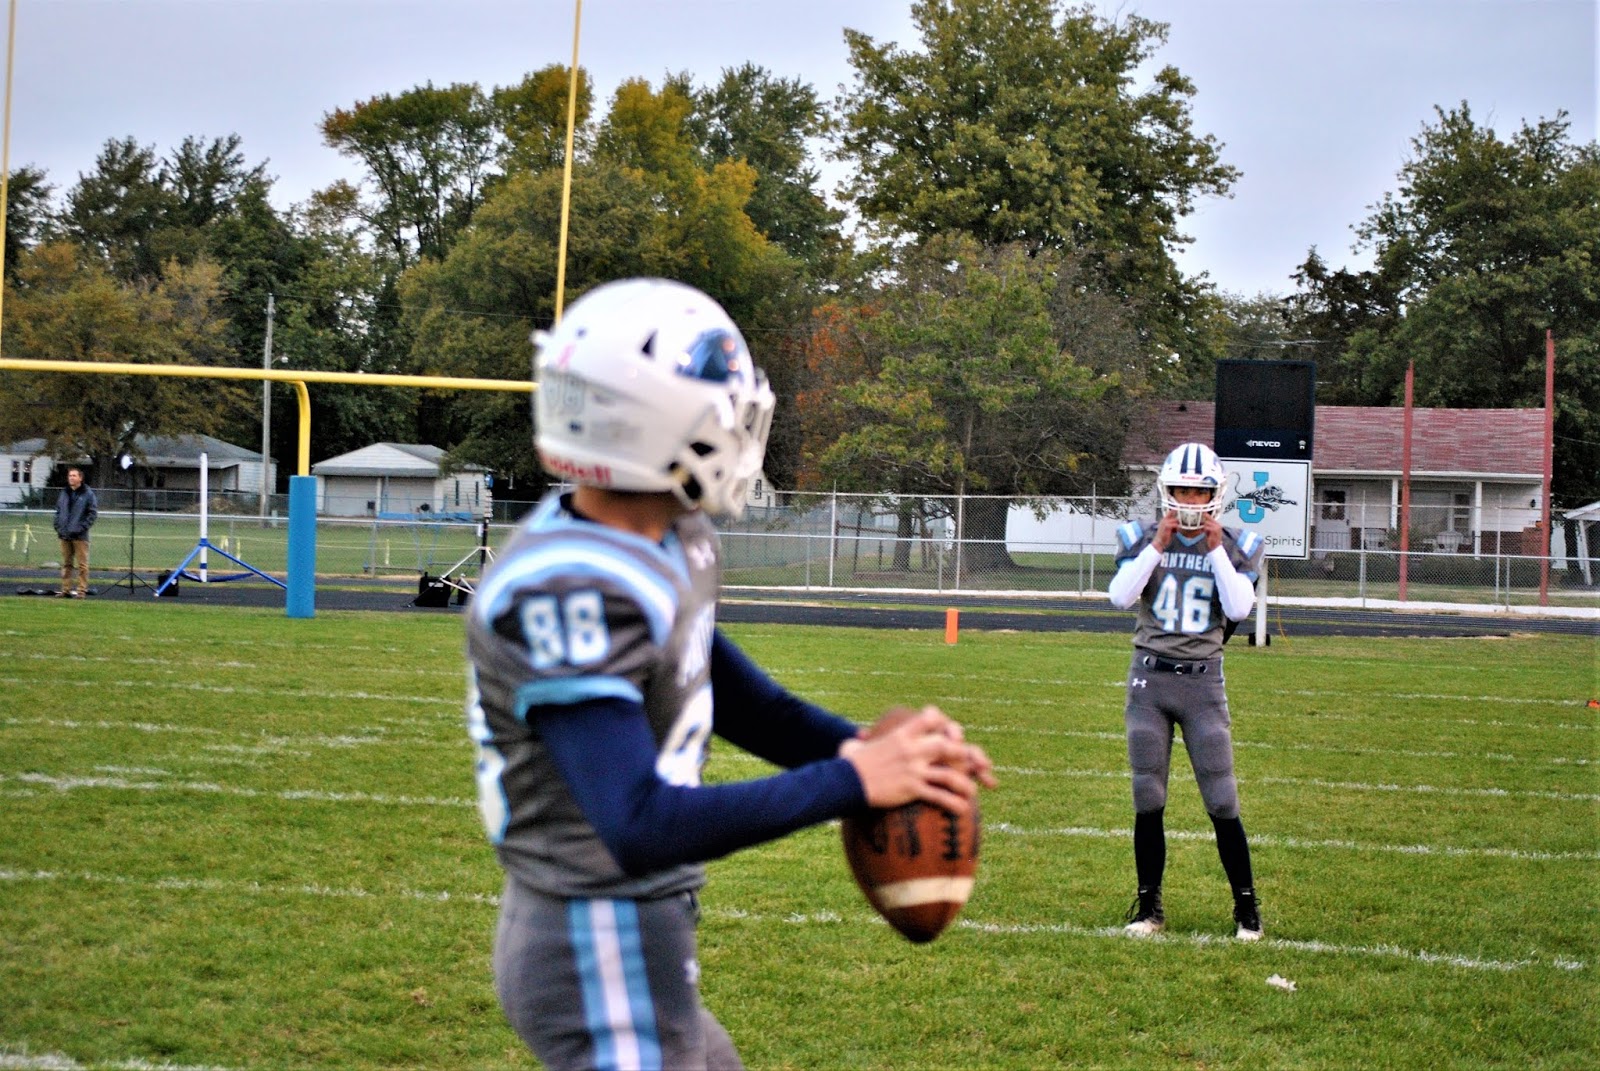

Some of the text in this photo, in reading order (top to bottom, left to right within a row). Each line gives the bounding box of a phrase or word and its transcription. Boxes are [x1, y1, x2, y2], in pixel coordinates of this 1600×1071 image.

[1251, 440, 1281, 448] NEVCO
[1264, 535, 1302, 548] Spirits
[1160, 551, 1213, 573] ANTHER
[1152, 573, 1214, 632] 46
